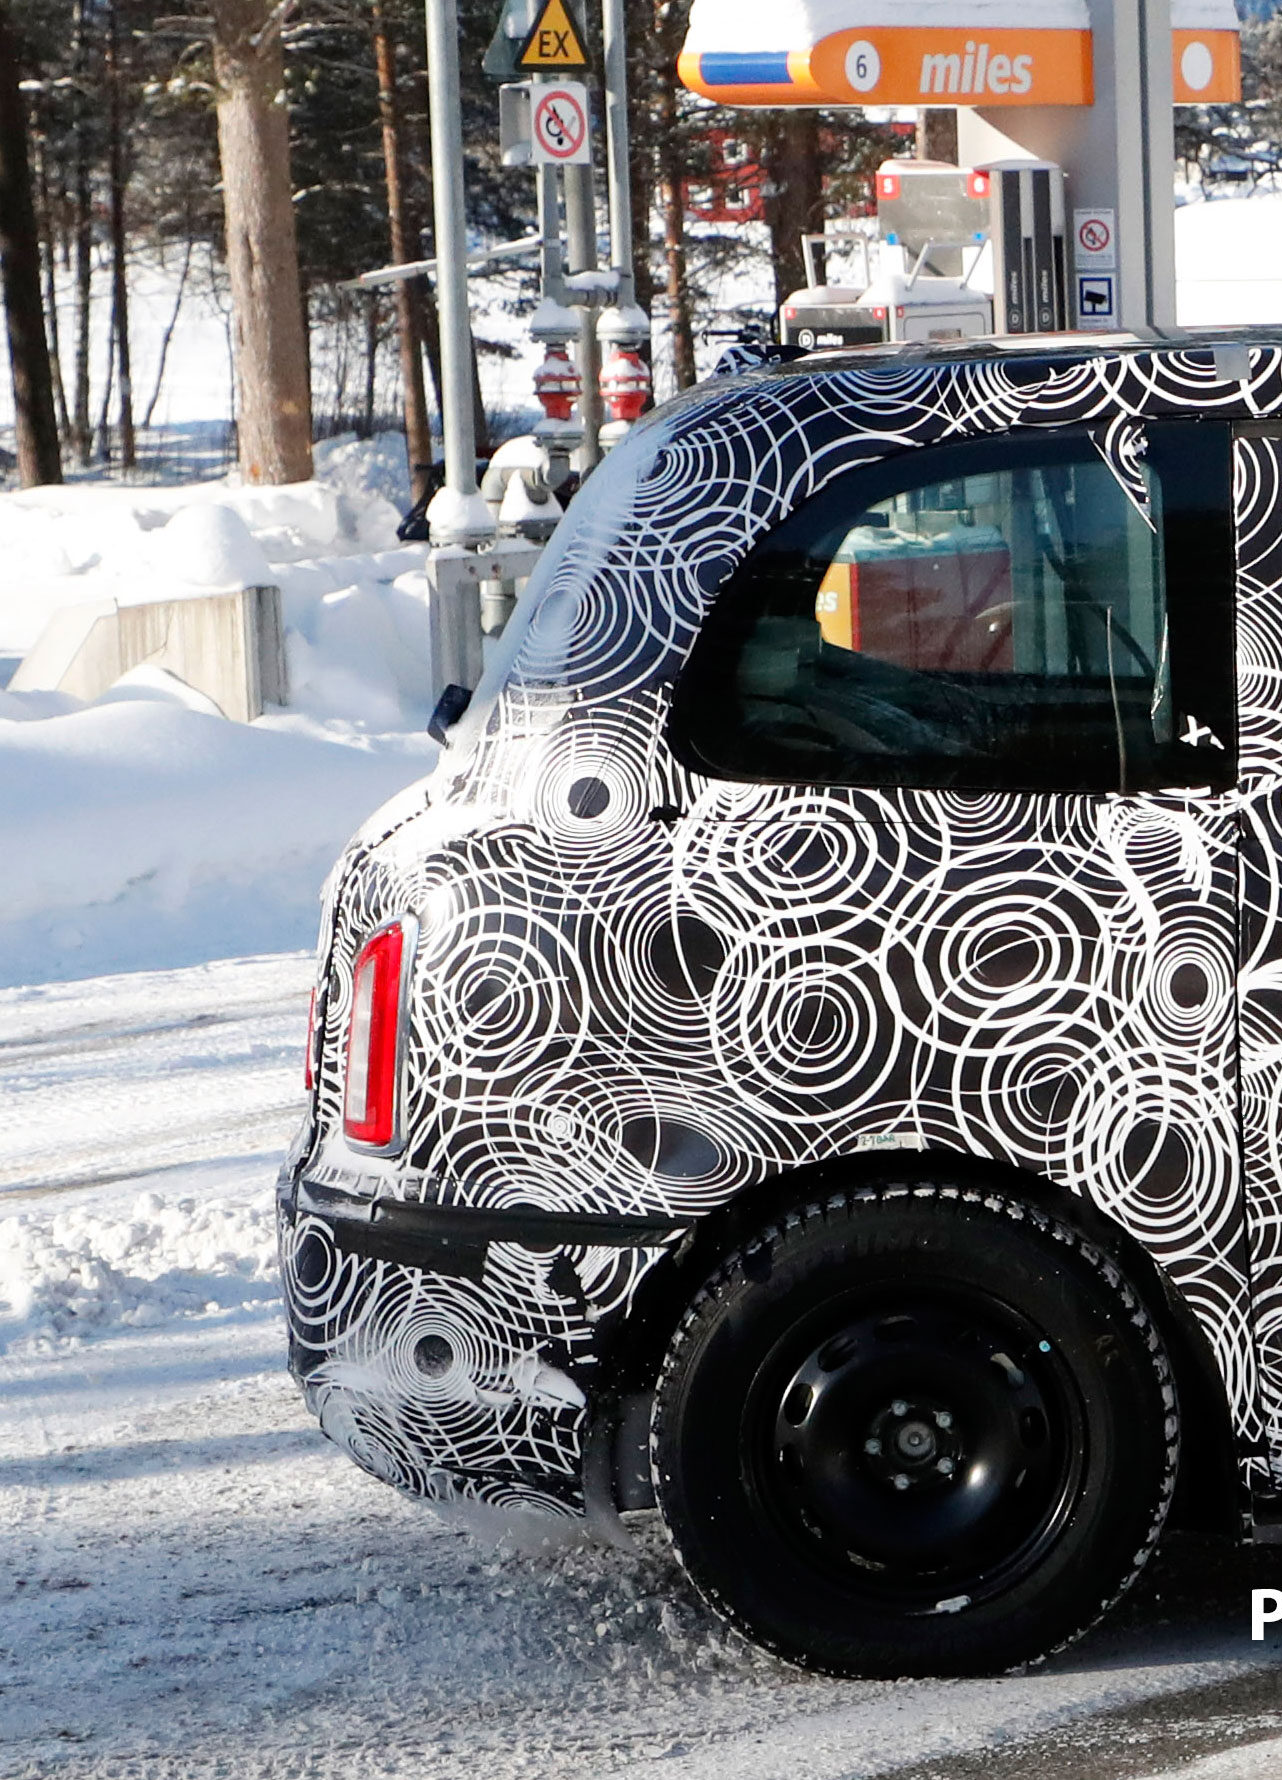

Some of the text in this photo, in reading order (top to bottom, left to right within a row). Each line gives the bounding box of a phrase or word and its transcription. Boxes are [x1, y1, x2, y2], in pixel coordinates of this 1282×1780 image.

[538, 30, 570, 58] EX
[856, 54, 867, 79] 6
[919, 40, 1033, 94] miles
[883, 178, 893, 193] 5
[974, 178, 984, 193] 6
